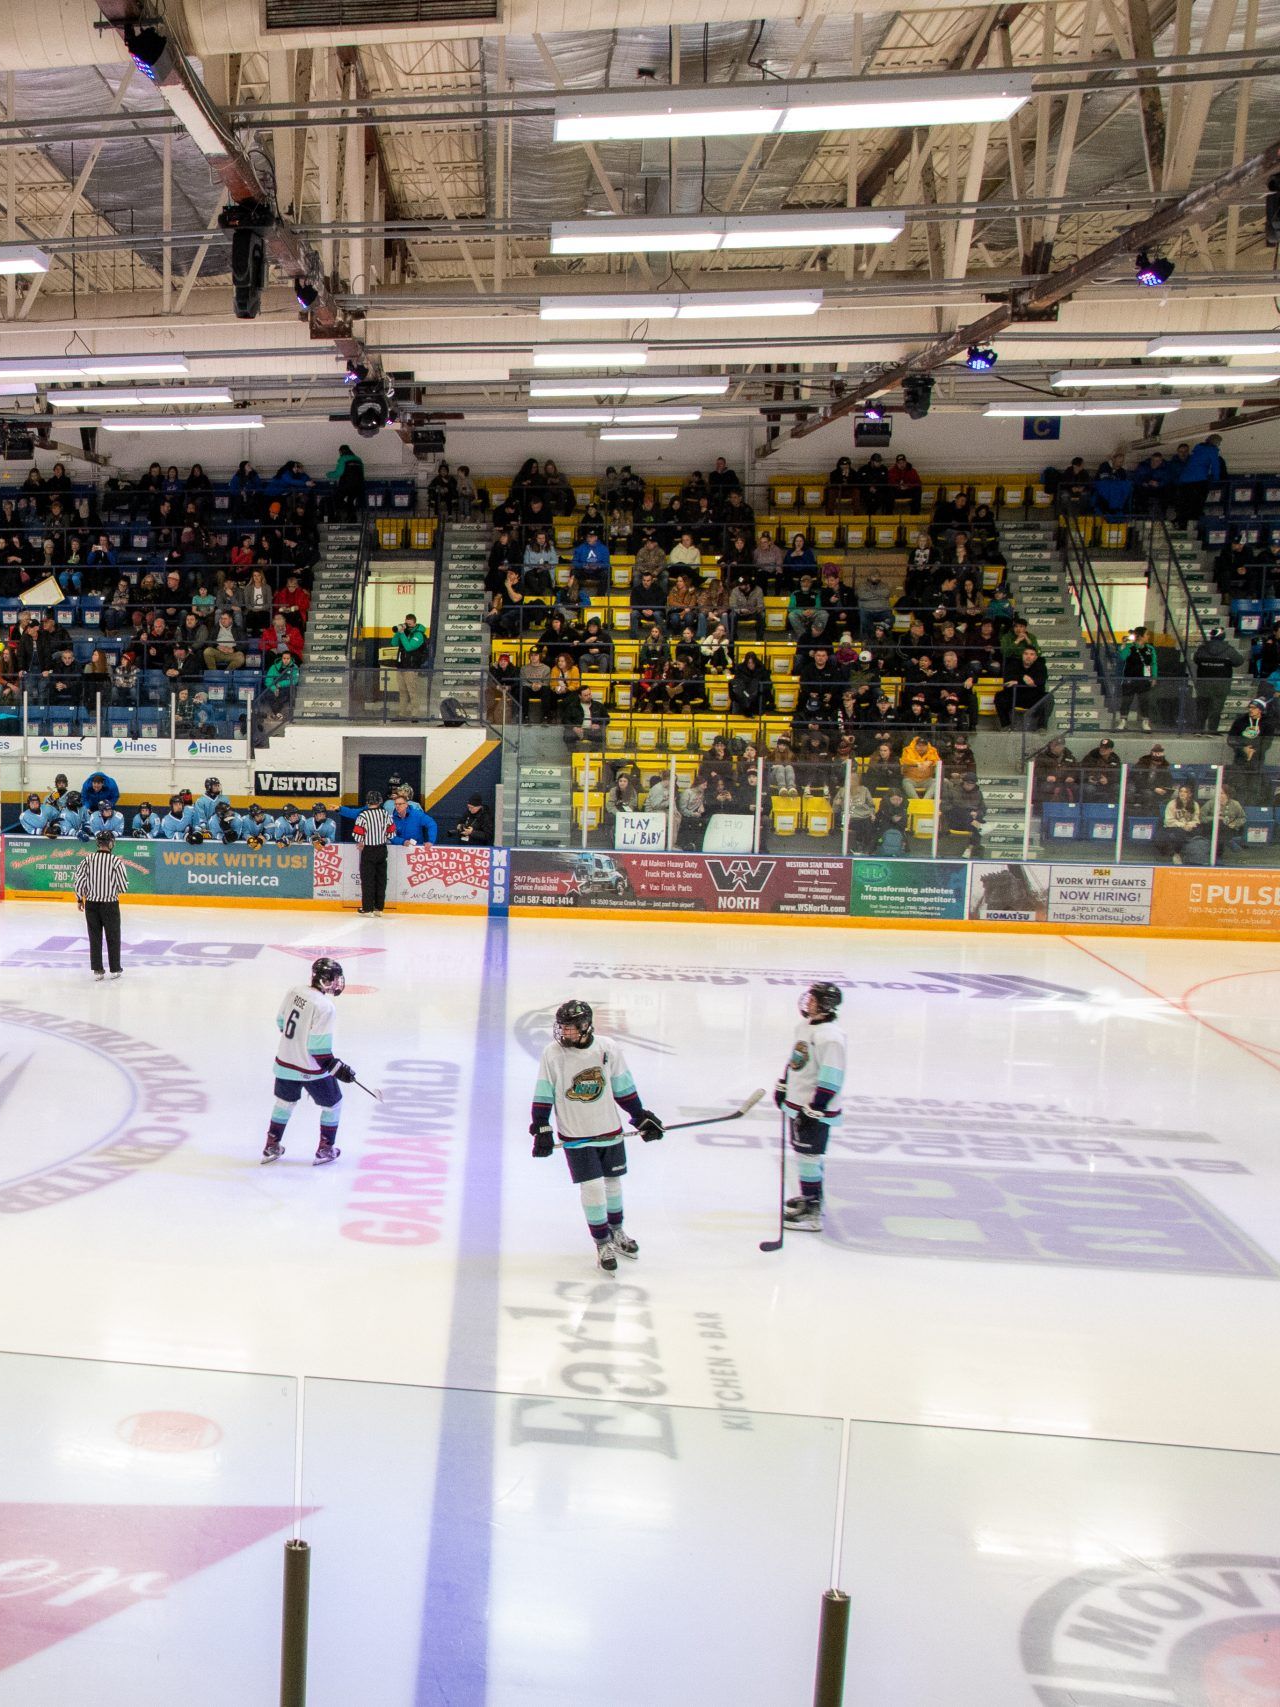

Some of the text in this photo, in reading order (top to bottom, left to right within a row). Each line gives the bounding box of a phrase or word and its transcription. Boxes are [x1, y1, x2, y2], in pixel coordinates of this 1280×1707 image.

[397, 585, 413, 595] EXIT
[50, 739, 83, 751] Hines
[124, 741, 157, 752] Hines
[199, 742, 232, 754] Hines
[257, 772, 338, 792] VISITORS
[163, 851, 219, 866] WORK
[223, 853, 272, 869] WITH
[277, 855, 308, 870] US!
[410, 853, 440, 864] SOLD
[646, 860, 667, 868] Makes
[667, 860, 684, 869] Heavy
[684, 861, 698, 869] Duty
[809, 861, 823, 869] STAR
[410, 868, 440, 885] SOLD
[445, 867, 475, 884] SOLD
[492, 849, 507, 904] MOB
[1093, 868, 1111, 876] P&H
[187, 870, 280, 888] bouchier.ca
[513, 875, 527, 883] 24/7
[527, 876, 541, 884] Parts
[1056, 877, 1147, 887] WORK WITH GIANTS
[513, 883, 558, 892] Service Available
[677, 884, 693, 892] Parts
[864, 884, 954, 895] Transforming athletes
[513, 895, 574, 905] Call 587-601-1414
[861, 893, 957, 904] into strong competitors
[1059, 890, 1141, 902] NOW HIRING!
[717, 896, 760, 909] NORTH
[779, 903, 846, 913] www.WSNorth.com
[986, 911, 1030, 921] KOMATSU
[293, 994, 308, 1010] ROSE
[284, 1008, 300, 1040] 6
[340, 1058, 462, 1246] GARDAWORLD
[501, 1280, 679, 1460] Earls
[705, 1343, 756, 1432] KITCHEN
